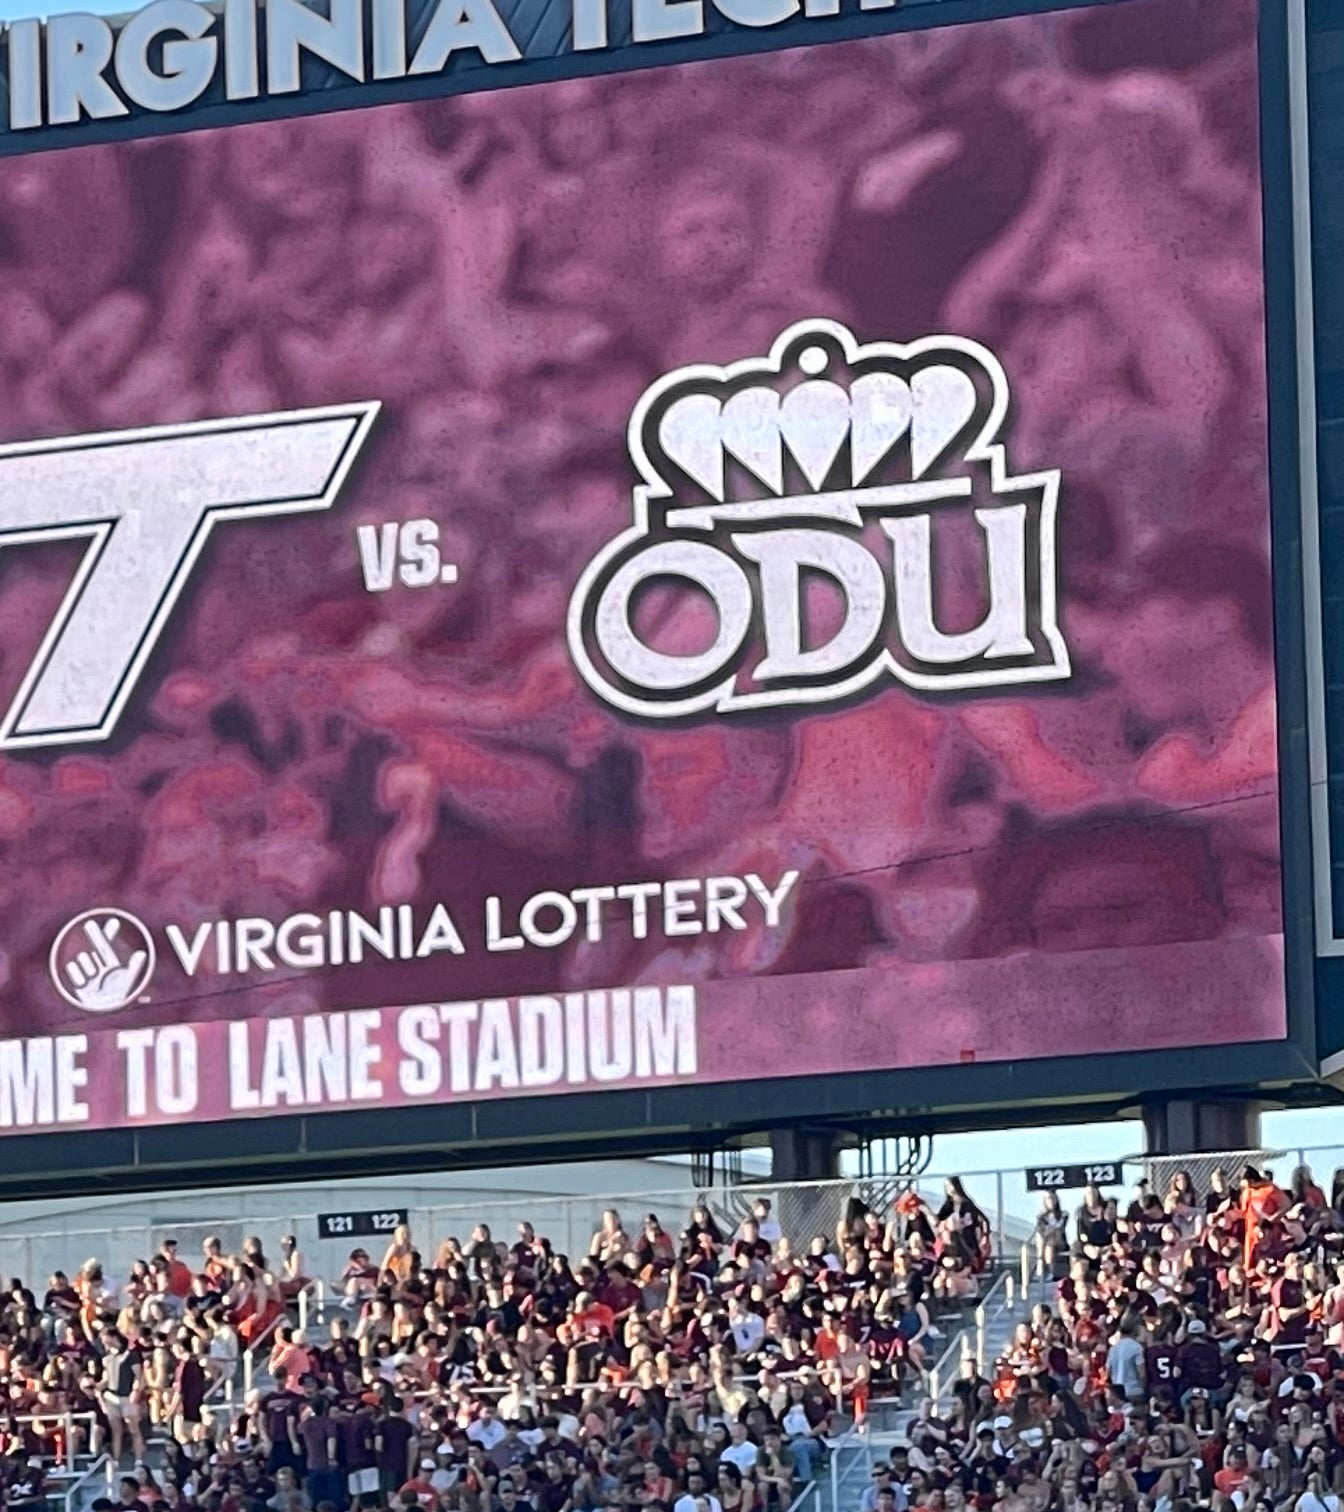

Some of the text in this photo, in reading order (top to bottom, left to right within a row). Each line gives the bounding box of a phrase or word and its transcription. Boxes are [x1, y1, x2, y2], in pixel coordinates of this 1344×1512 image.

[584, 498, 1047, 710] ODU
[164, 868, 801, 979] VIRGINIA LOTTERY
[117, 1024, 198, 1118] TO
[227, 1007, 383, 1110] LANE
[397, 984, 697, 1098] STADIUM
[327, 1213, 400, 1232] 121 122
[1034, 1166, 1115, 1185] 122 123
